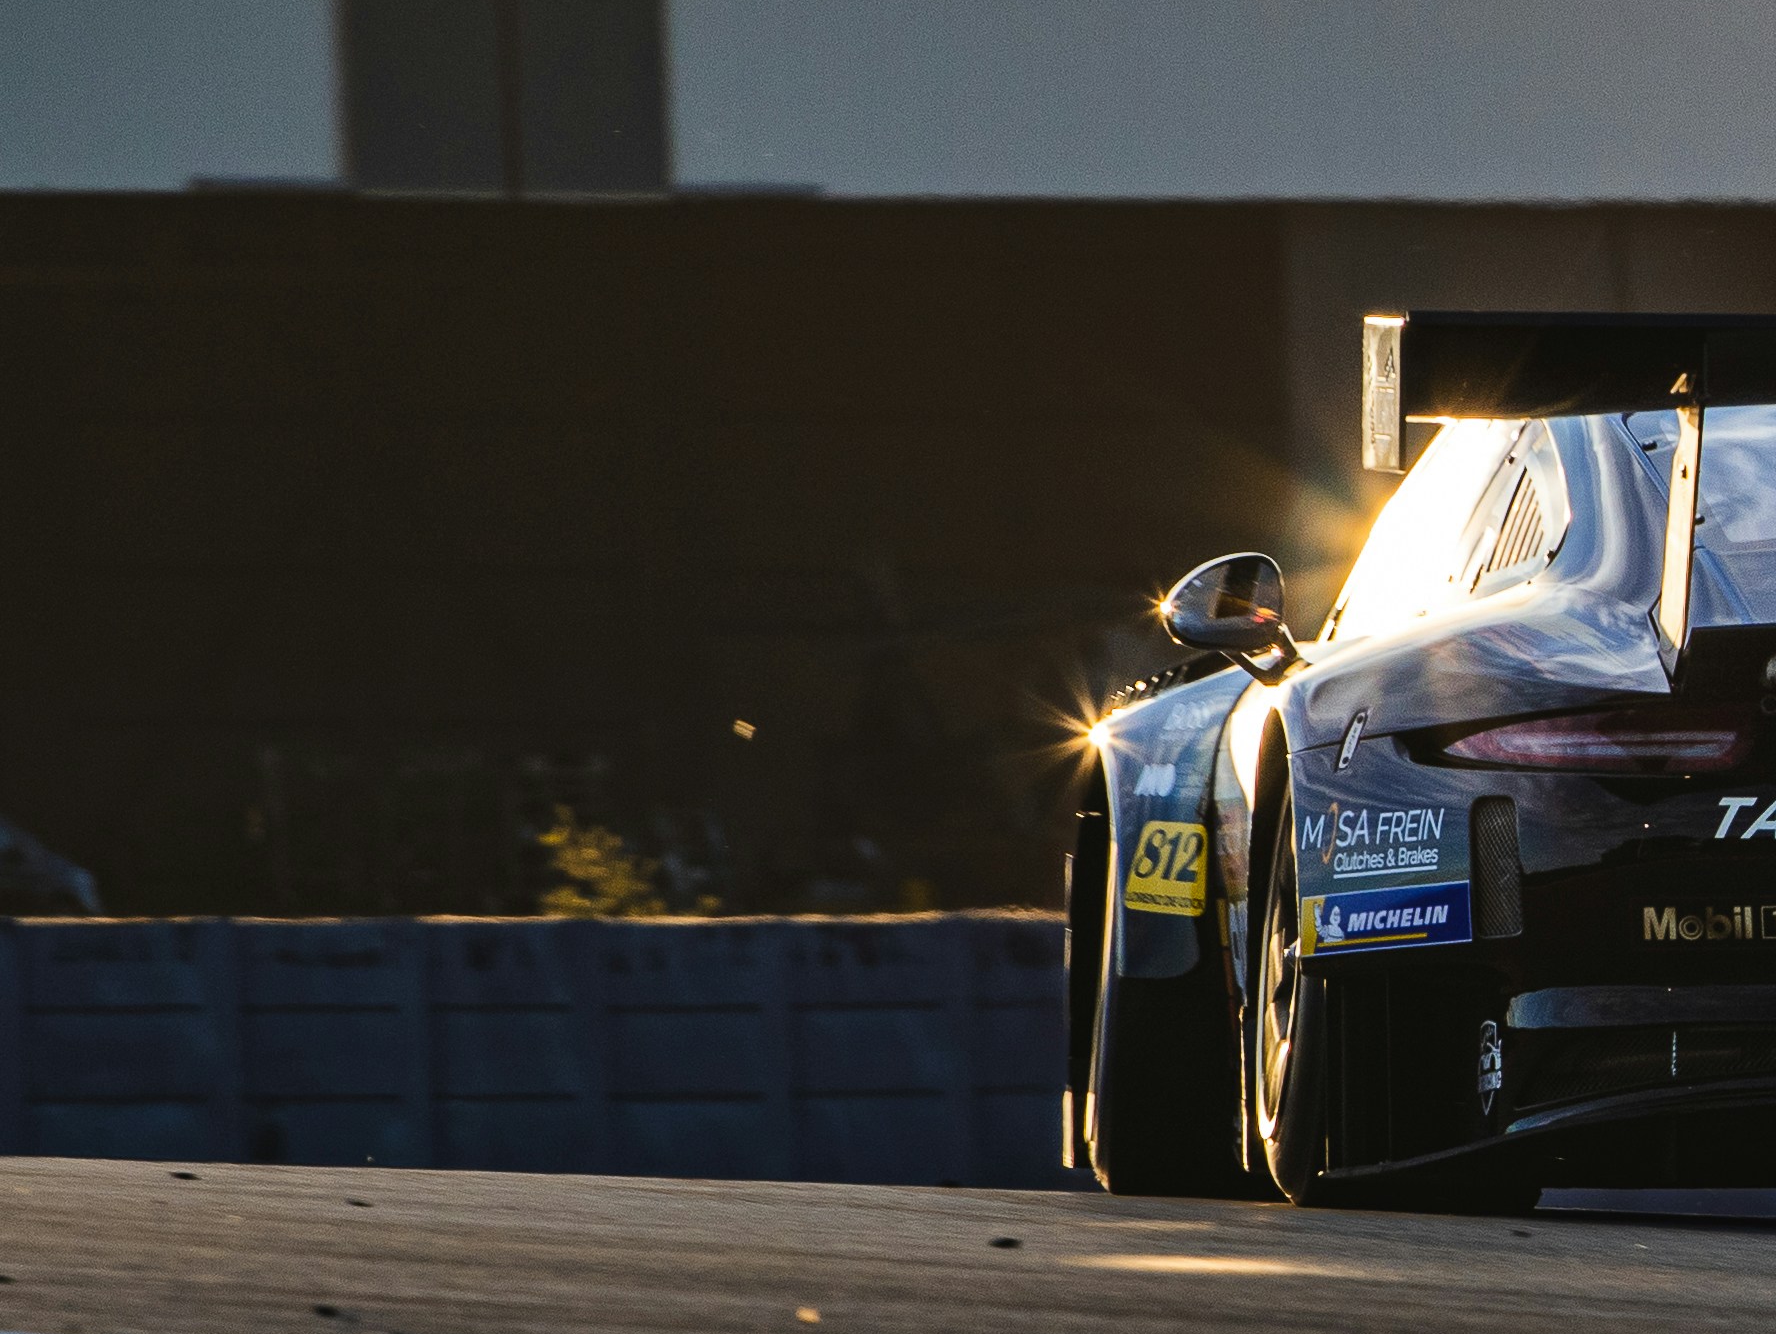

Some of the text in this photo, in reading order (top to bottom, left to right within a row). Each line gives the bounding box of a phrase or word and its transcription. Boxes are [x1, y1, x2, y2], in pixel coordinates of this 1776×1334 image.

[1376, 808, 1445, 845] FREIN
[1333, 845, 1439, 873] Clutches & Brakes
[1347, 905, 1449, 933] MICHELIN
[1643, 906, 1753, 940] Mobil
